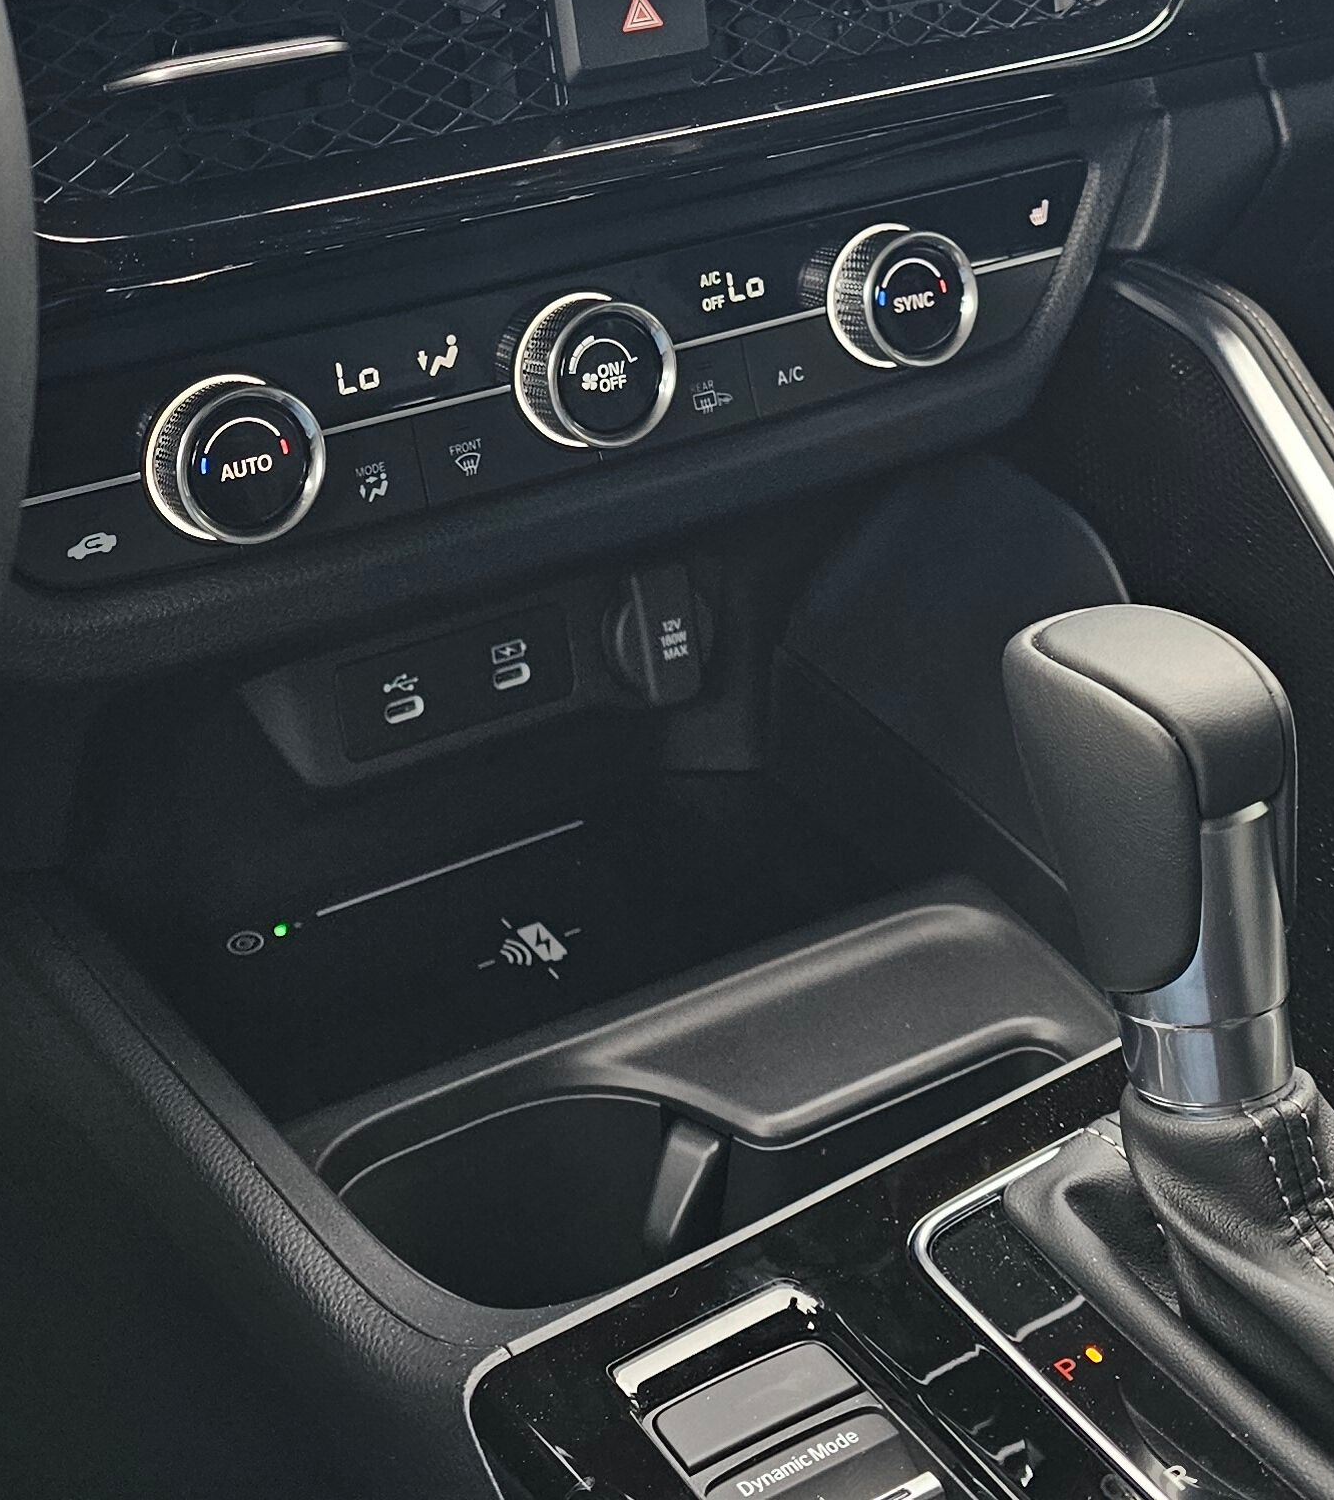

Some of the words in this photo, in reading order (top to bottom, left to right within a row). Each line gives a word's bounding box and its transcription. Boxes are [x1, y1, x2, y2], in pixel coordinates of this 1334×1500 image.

[700, 270, 722, 288] A/C
[725, 271, 765, 302] Lo
[702, 294, 725, 312] OFF
[893, 291, 935, 313] SYNC
[335, 362, 380, 396] Lo
[597, 360, 625, 379] ON/
[777, 365, 805, 386] A/C
[599, 374, 627, 393] OFF
[449, 438, 482, 456] FRONT
[220, 454, 273, 483] AUTO
[355, 462, 386, 478] MODE
[661, 618, 681, 633] 12V
[663, 644, 689, 660] MAX
[1053, 1358, 1076, 1381] P
[736, 1452, 813, 1497] Dynamic
[807, 1431, 860, 1462] Mode
[1163, 1465, 1198, 1491] R
